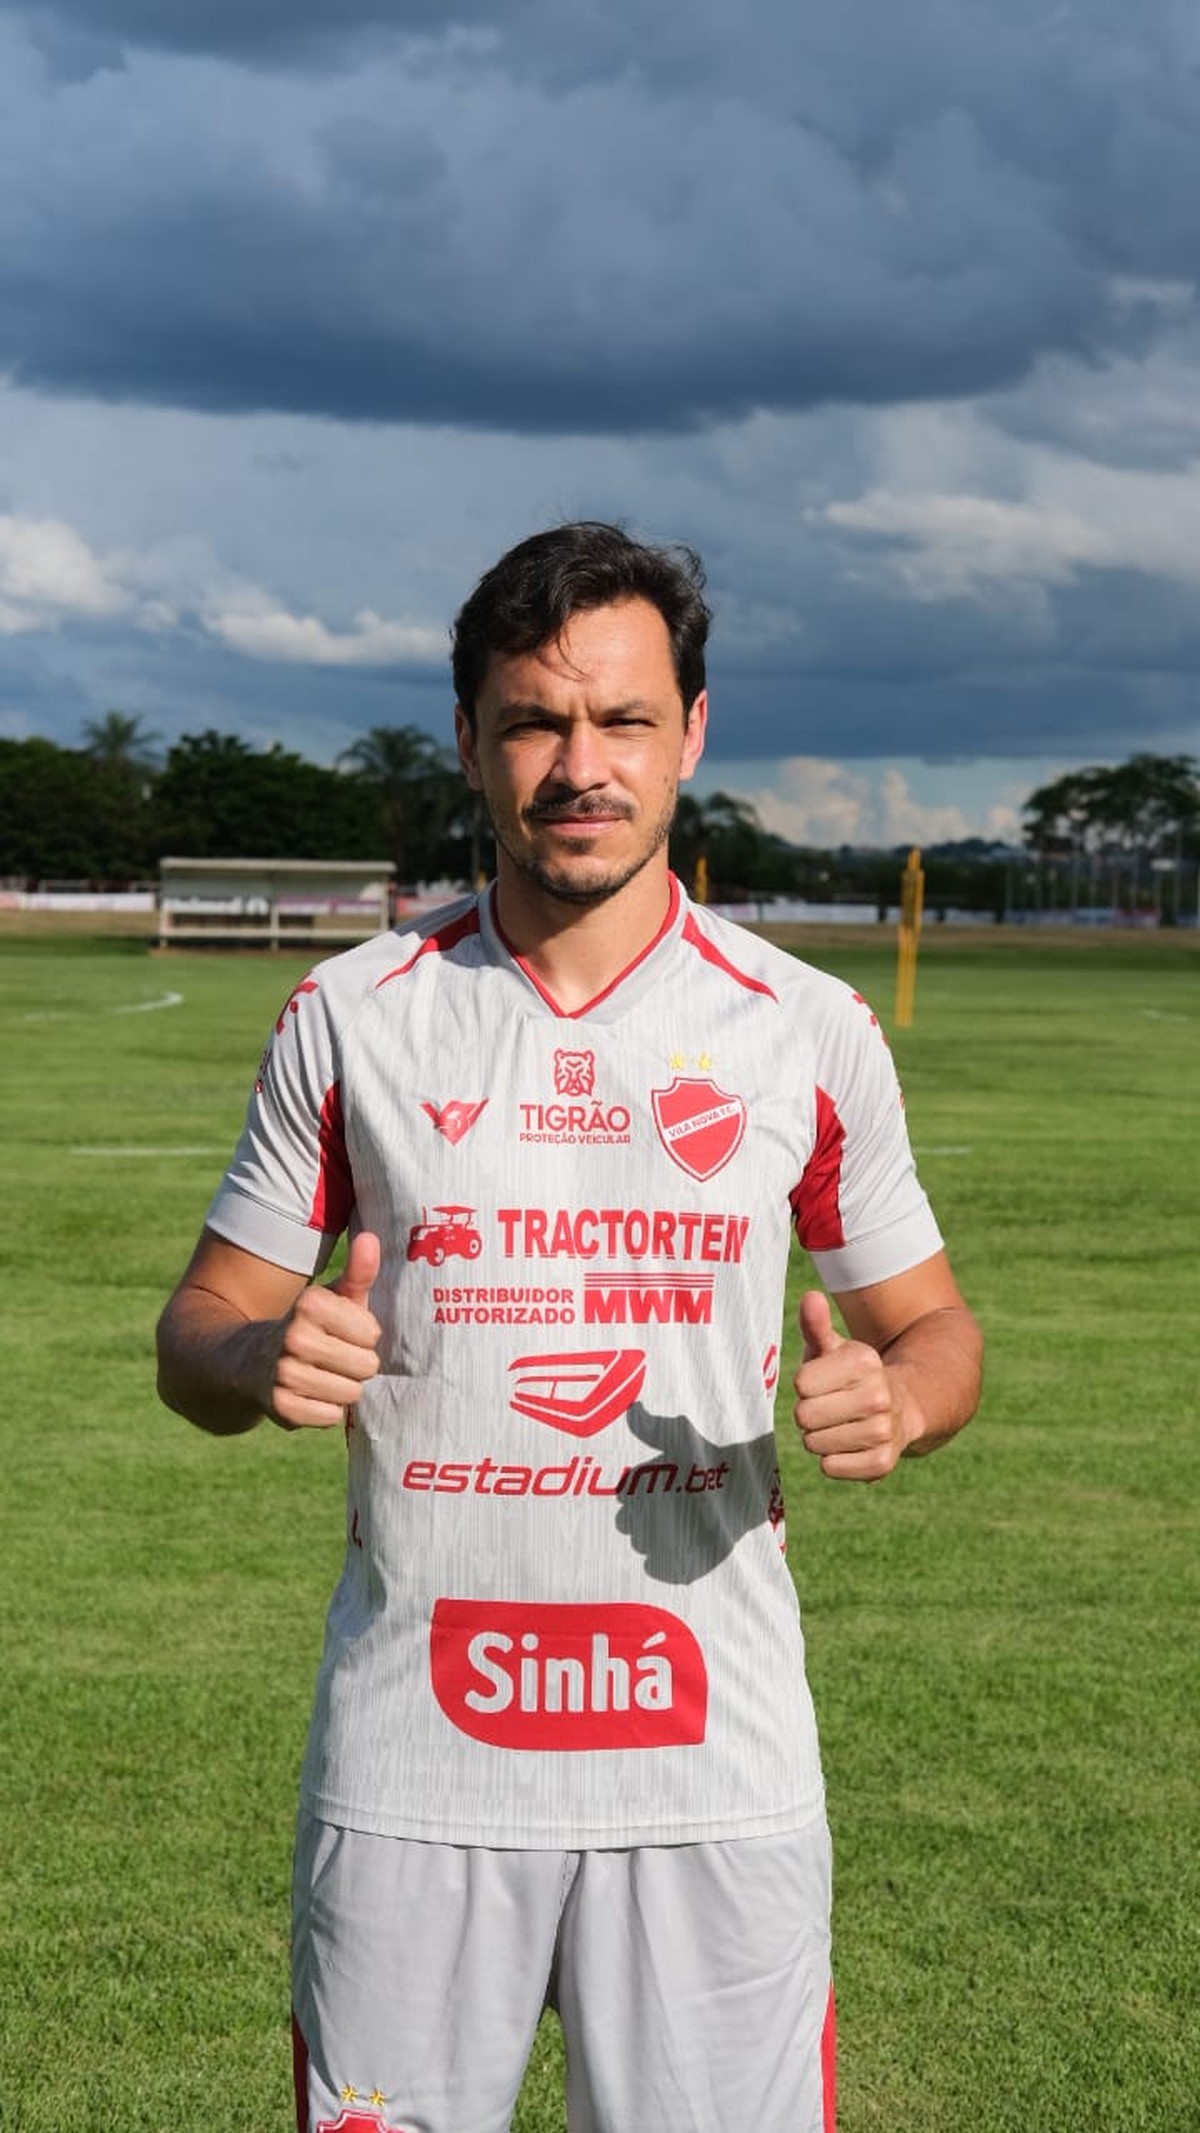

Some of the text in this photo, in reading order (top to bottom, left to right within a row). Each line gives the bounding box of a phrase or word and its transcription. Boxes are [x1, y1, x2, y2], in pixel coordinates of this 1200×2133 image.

[519, 1100, 631, 1132] TIGRÃO
[668, 1122, 691, 1137] VILA
[691, 1111, 720, 1127] NOVA
[519, 1132, 631, 1145] PROTEÇÃO VEICULAR
[497, 1209, 749, 1263] TRACTORTEN
[433, 1288, 574, 1304] DISTRIBUIDOR
[584, 1289, 713, 1325] MWM
[433, 1307, 576, 1325] AUTORIZADO
[402, 1456, 729, 1496] estadium.bet
[465, 1631, 673, 1713] Sinhá
